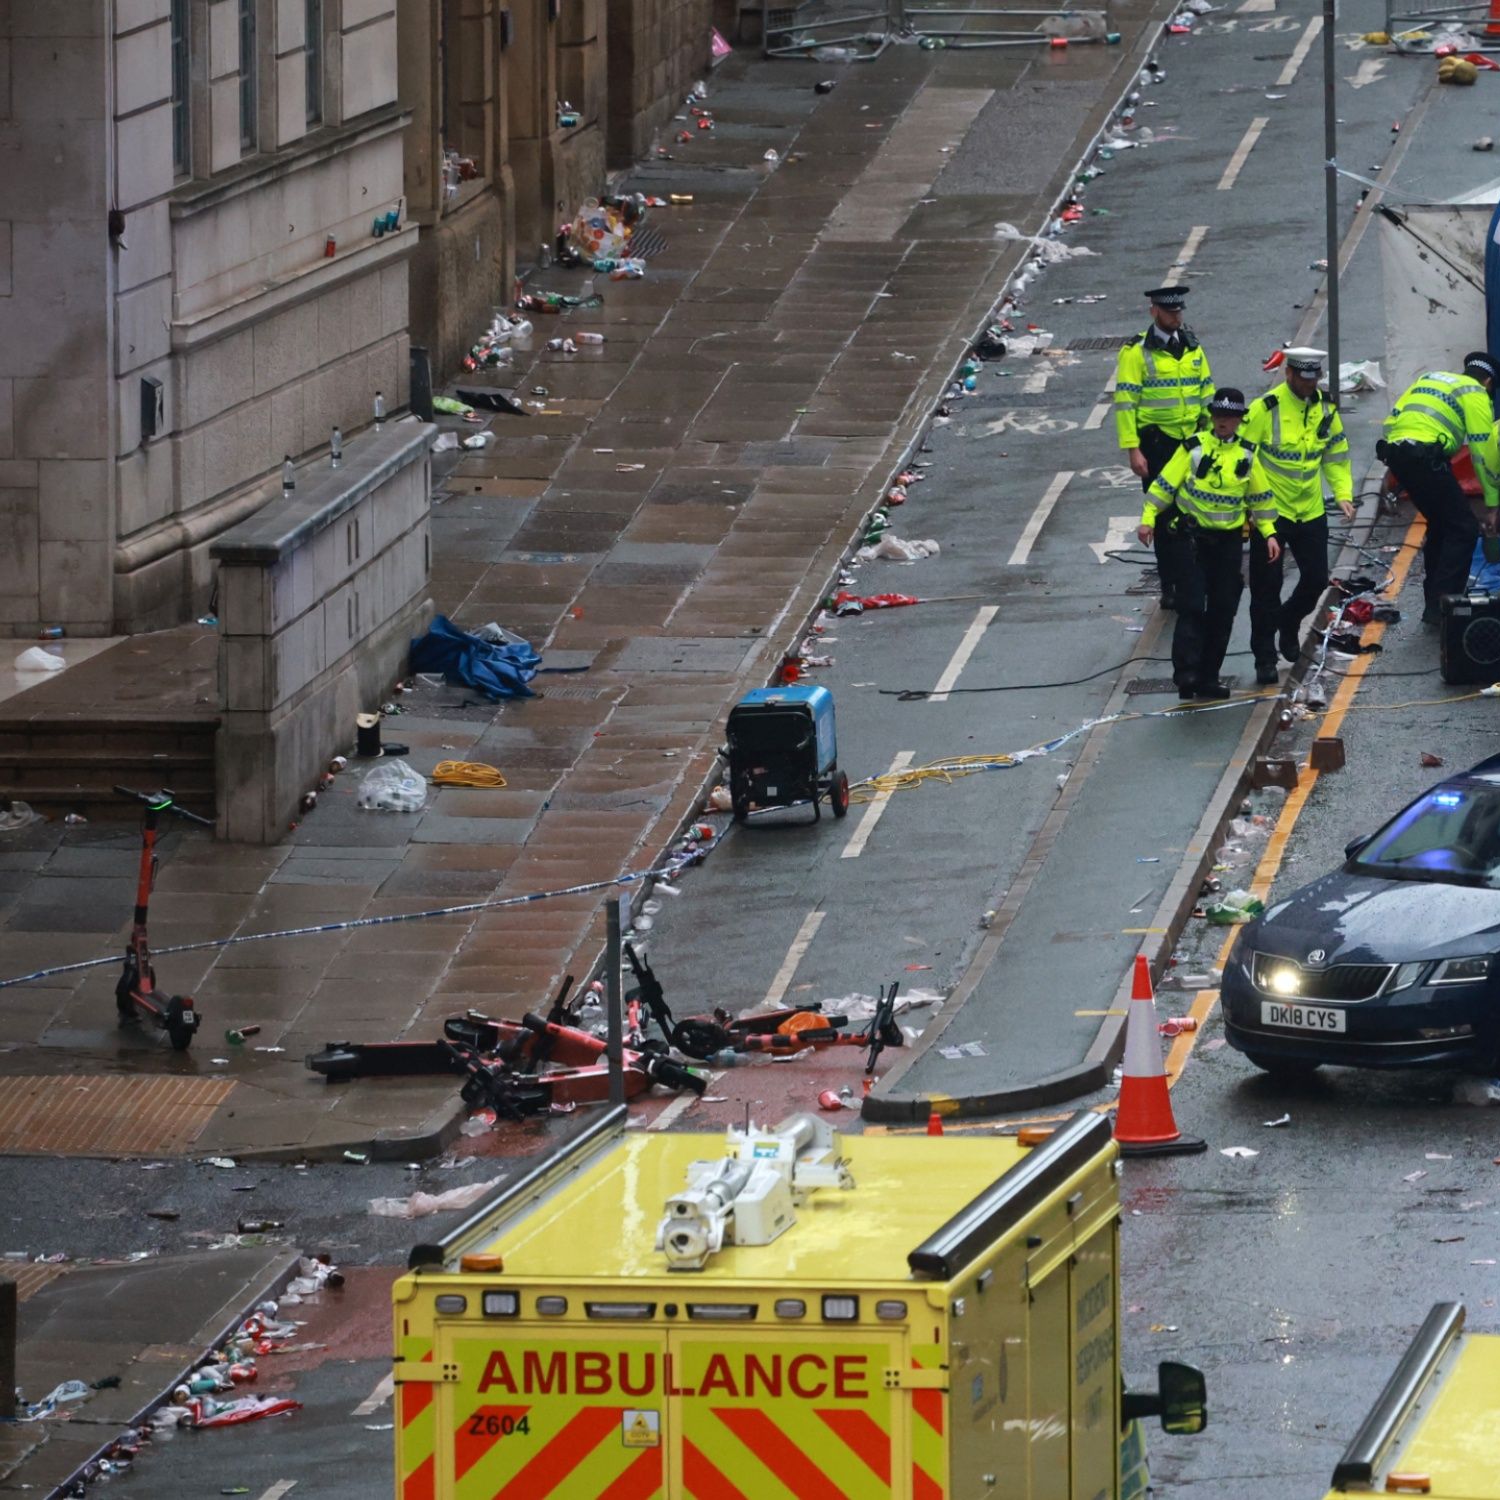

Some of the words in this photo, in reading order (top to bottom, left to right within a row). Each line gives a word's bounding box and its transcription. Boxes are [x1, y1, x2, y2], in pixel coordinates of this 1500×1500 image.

[1270, 1005, 1303, 1025] DK18
[1306, 1009, 1337, 1029] CYS
[477, 1350, 869, 1399] AMBULANCE
[469, 1415, 531, 1436] Z604
